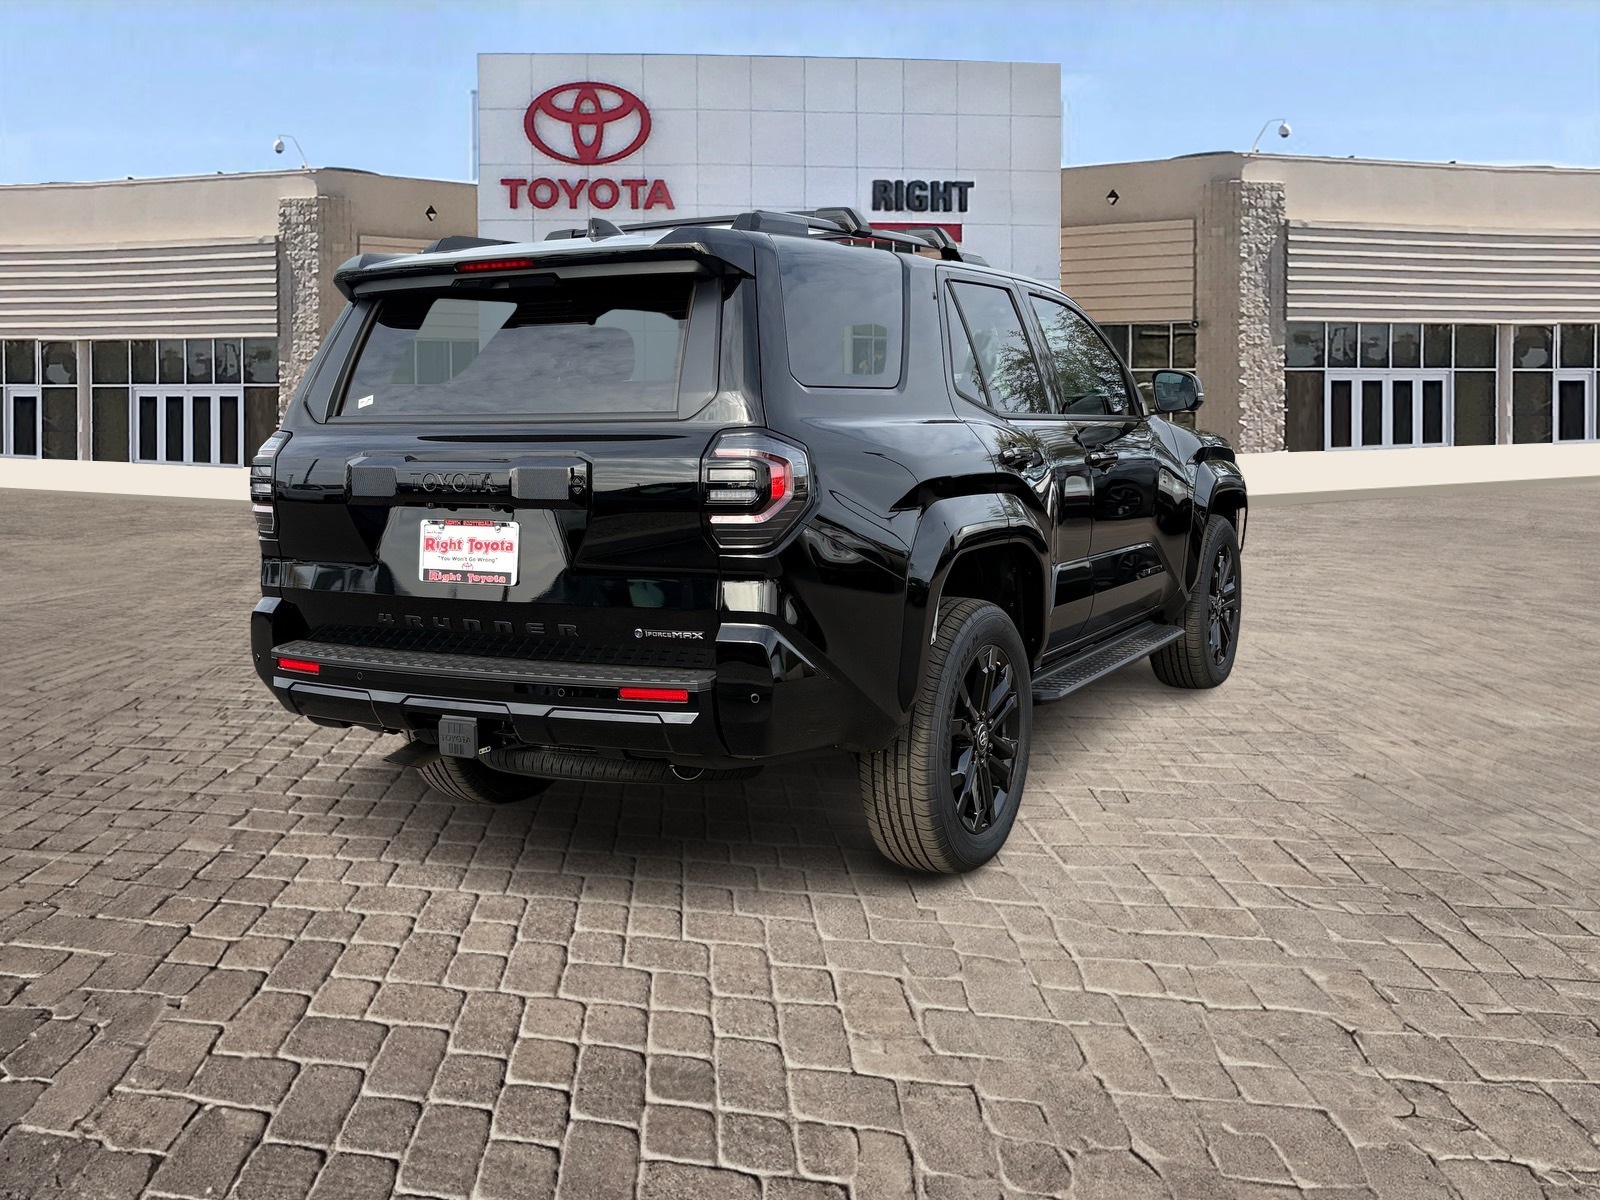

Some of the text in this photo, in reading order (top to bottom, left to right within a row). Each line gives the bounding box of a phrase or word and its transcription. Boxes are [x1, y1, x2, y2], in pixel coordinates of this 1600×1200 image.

[501, 177, 675, 209] TOYOTA
[872, 179, 975, 212] RIGHT
[410, 473, 497, 492] TOYOTA
[425, 536, 514, 554] Right Toyota
[429, 569, 507, 584] Right Toyota
[378, 612, 579, 637] 4RUNNER
[441, 733, 471, 744] TOYOTA
